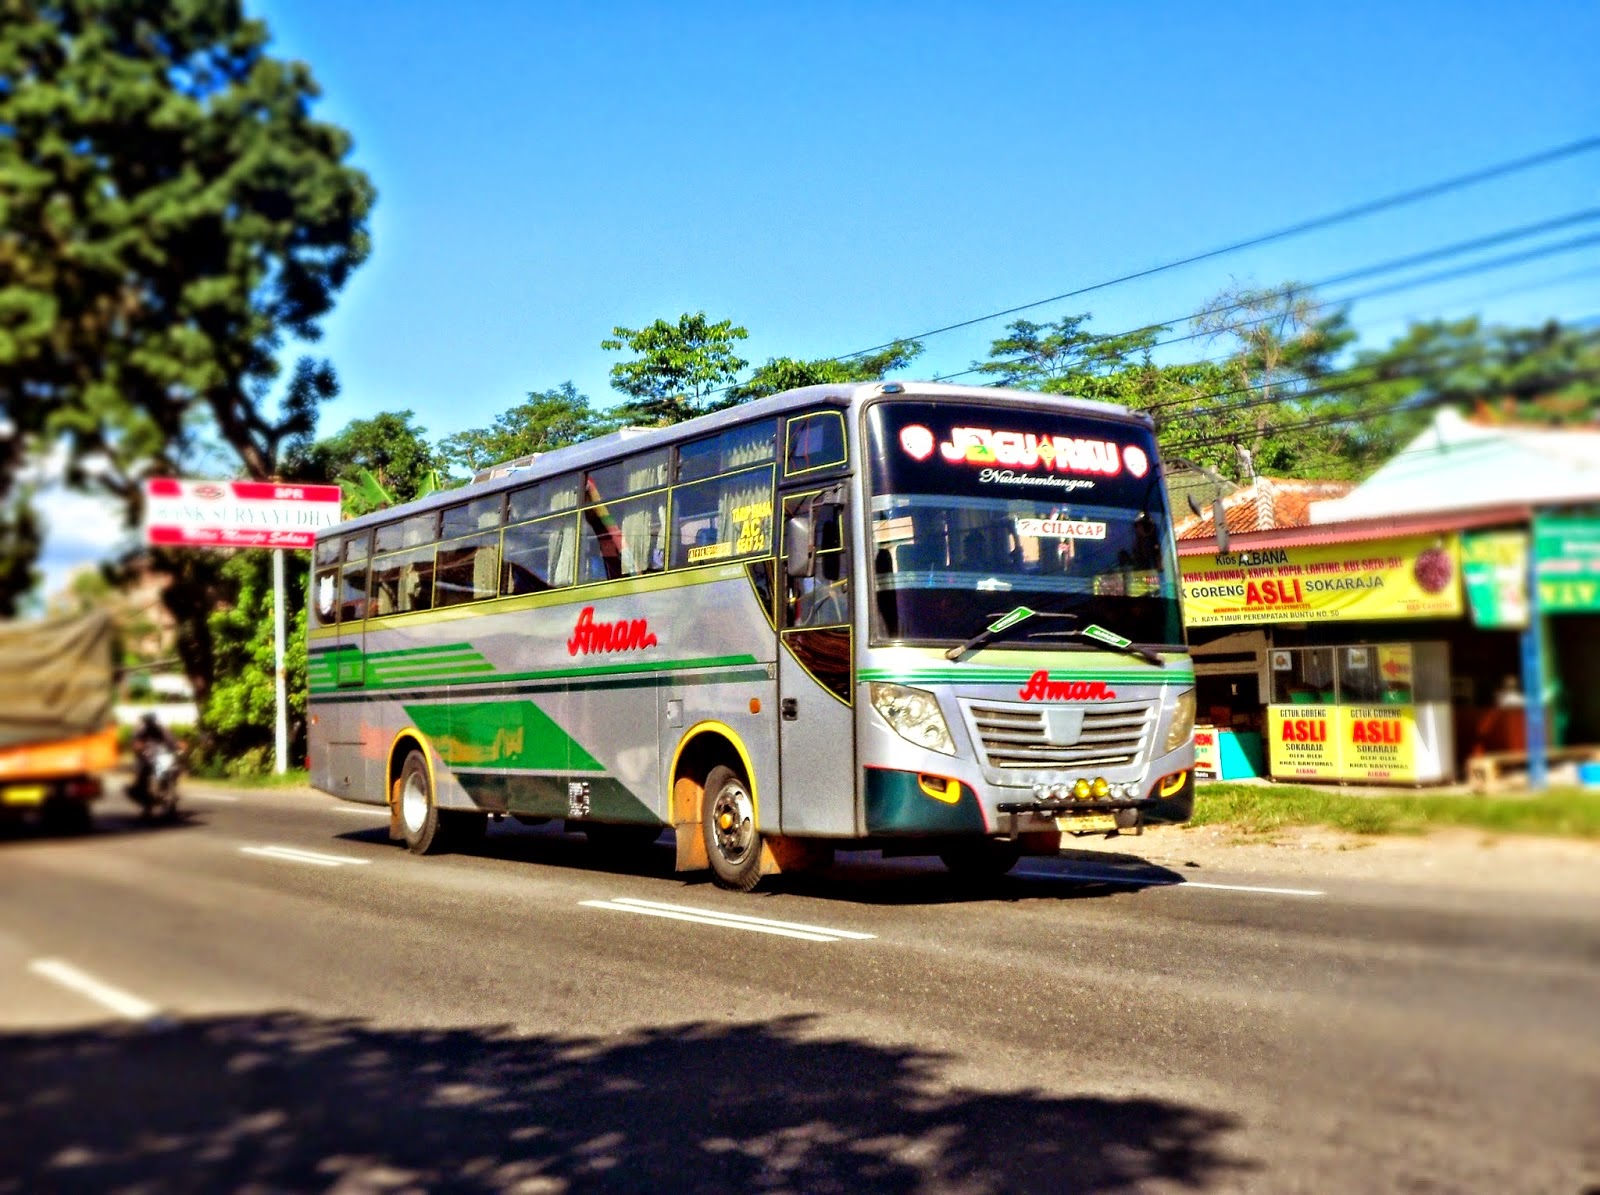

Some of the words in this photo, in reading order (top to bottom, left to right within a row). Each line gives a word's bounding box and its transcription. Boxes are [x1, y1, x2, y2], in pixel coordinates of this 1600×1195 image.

[979, 468, 1095, 491] Nusakambangan
[275, 488, 304, 499] BPR
[741, 517, 761, 539] AC
[1042, 522, 1104, 536] CILACAP
[1238, 550, 1288, 566] ALBANA
[1191, 585, 1245, 598] GORENG
[1246, 579, 1303, 605] ASLI
[1305, 576, 1384, 592] SOKARAJA
[1220, 614, 1242, 622] TIMUR
[1244, 612, 1289, 621] PEREMPATAN
[1290, 611, 1315, 620] BUNTU
[567, 606, 657, 656] Aman
[1019, 669, 1116, 700] Aman
[1282, 720, 1327, 742] ASLI
[1352, 720, 1401, 743] ASLI
[1286, 743, 1324, 751] SOKARAJA
[1356, 745, 1398, 753] SOKARAJA
